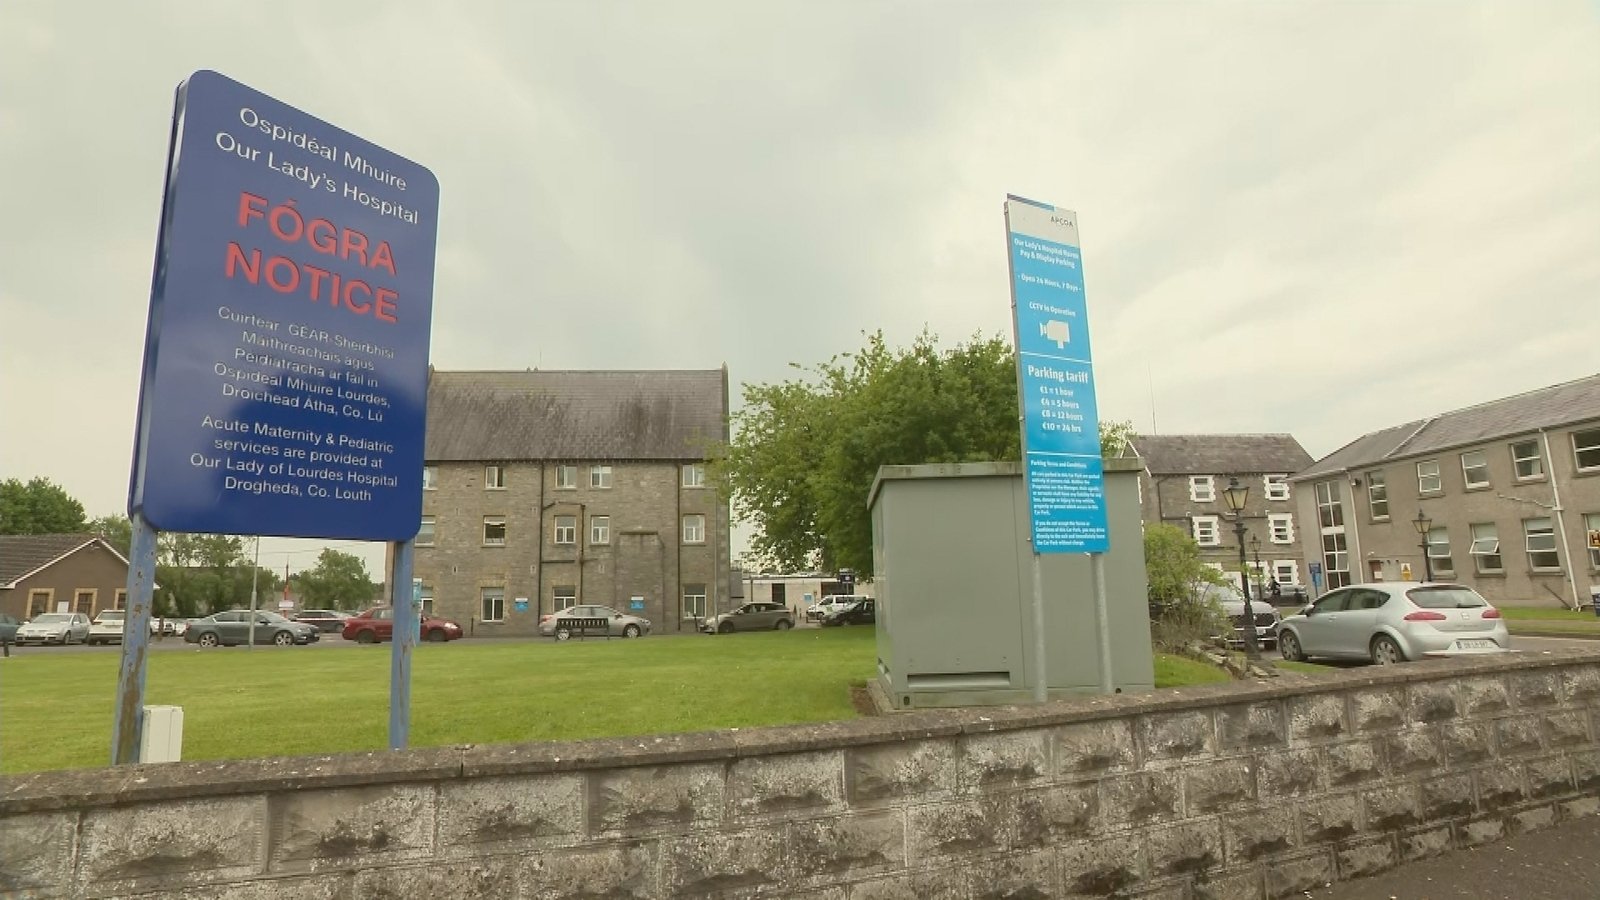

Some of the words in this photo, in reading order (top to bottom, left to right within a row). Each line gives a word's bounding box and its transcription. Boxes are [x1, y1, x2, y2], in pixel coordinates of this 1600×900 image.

[239, 107, 337, 162] Ospidéal
[344, 151, 407, 191] Mhuire
[215, 132, 261, 162] Our
[268, 152, 336, 193] Lady's
[343, 182, 418, 225] Hospital
[238, 191, 397, 278] FÓGRA
[224, 241, 399, 324] NOTICE
[218, 306, 280, 332] Cuirtear
[344, 356, 375, 372] agus
[1028, 365, 1064, 383] Parking
[1066, 371, 1088, 383] tariff
[223, 383, 300, 408] Droichead
[342, 404, 364, 419] Co.
[287, 376, 334, 396] Mhuire
[202, 415, 249, 433] Acute
[254, 422, 322, 446] Maternity
[325, 433, 335, 445] &
[339, 435, 394, 454] Pediatric
[190, 453, 221, 468] Our
[226, 457, 264, 475] Lady
[269, 463, 284, 474] of
[288, 465, 343, 481] Lourdes
[347, 471, 398, 488] Hospital
[214, 439, 279, 456] services
[283, 447, 306, 458] are
[310, 451, 368, 467] provided
[370, 459, 383, 469] at
[225, 476, 302, 497] Drogheda,
[308, 485, 331, 498] Co.
[335, 487, 371, 501] Louth
